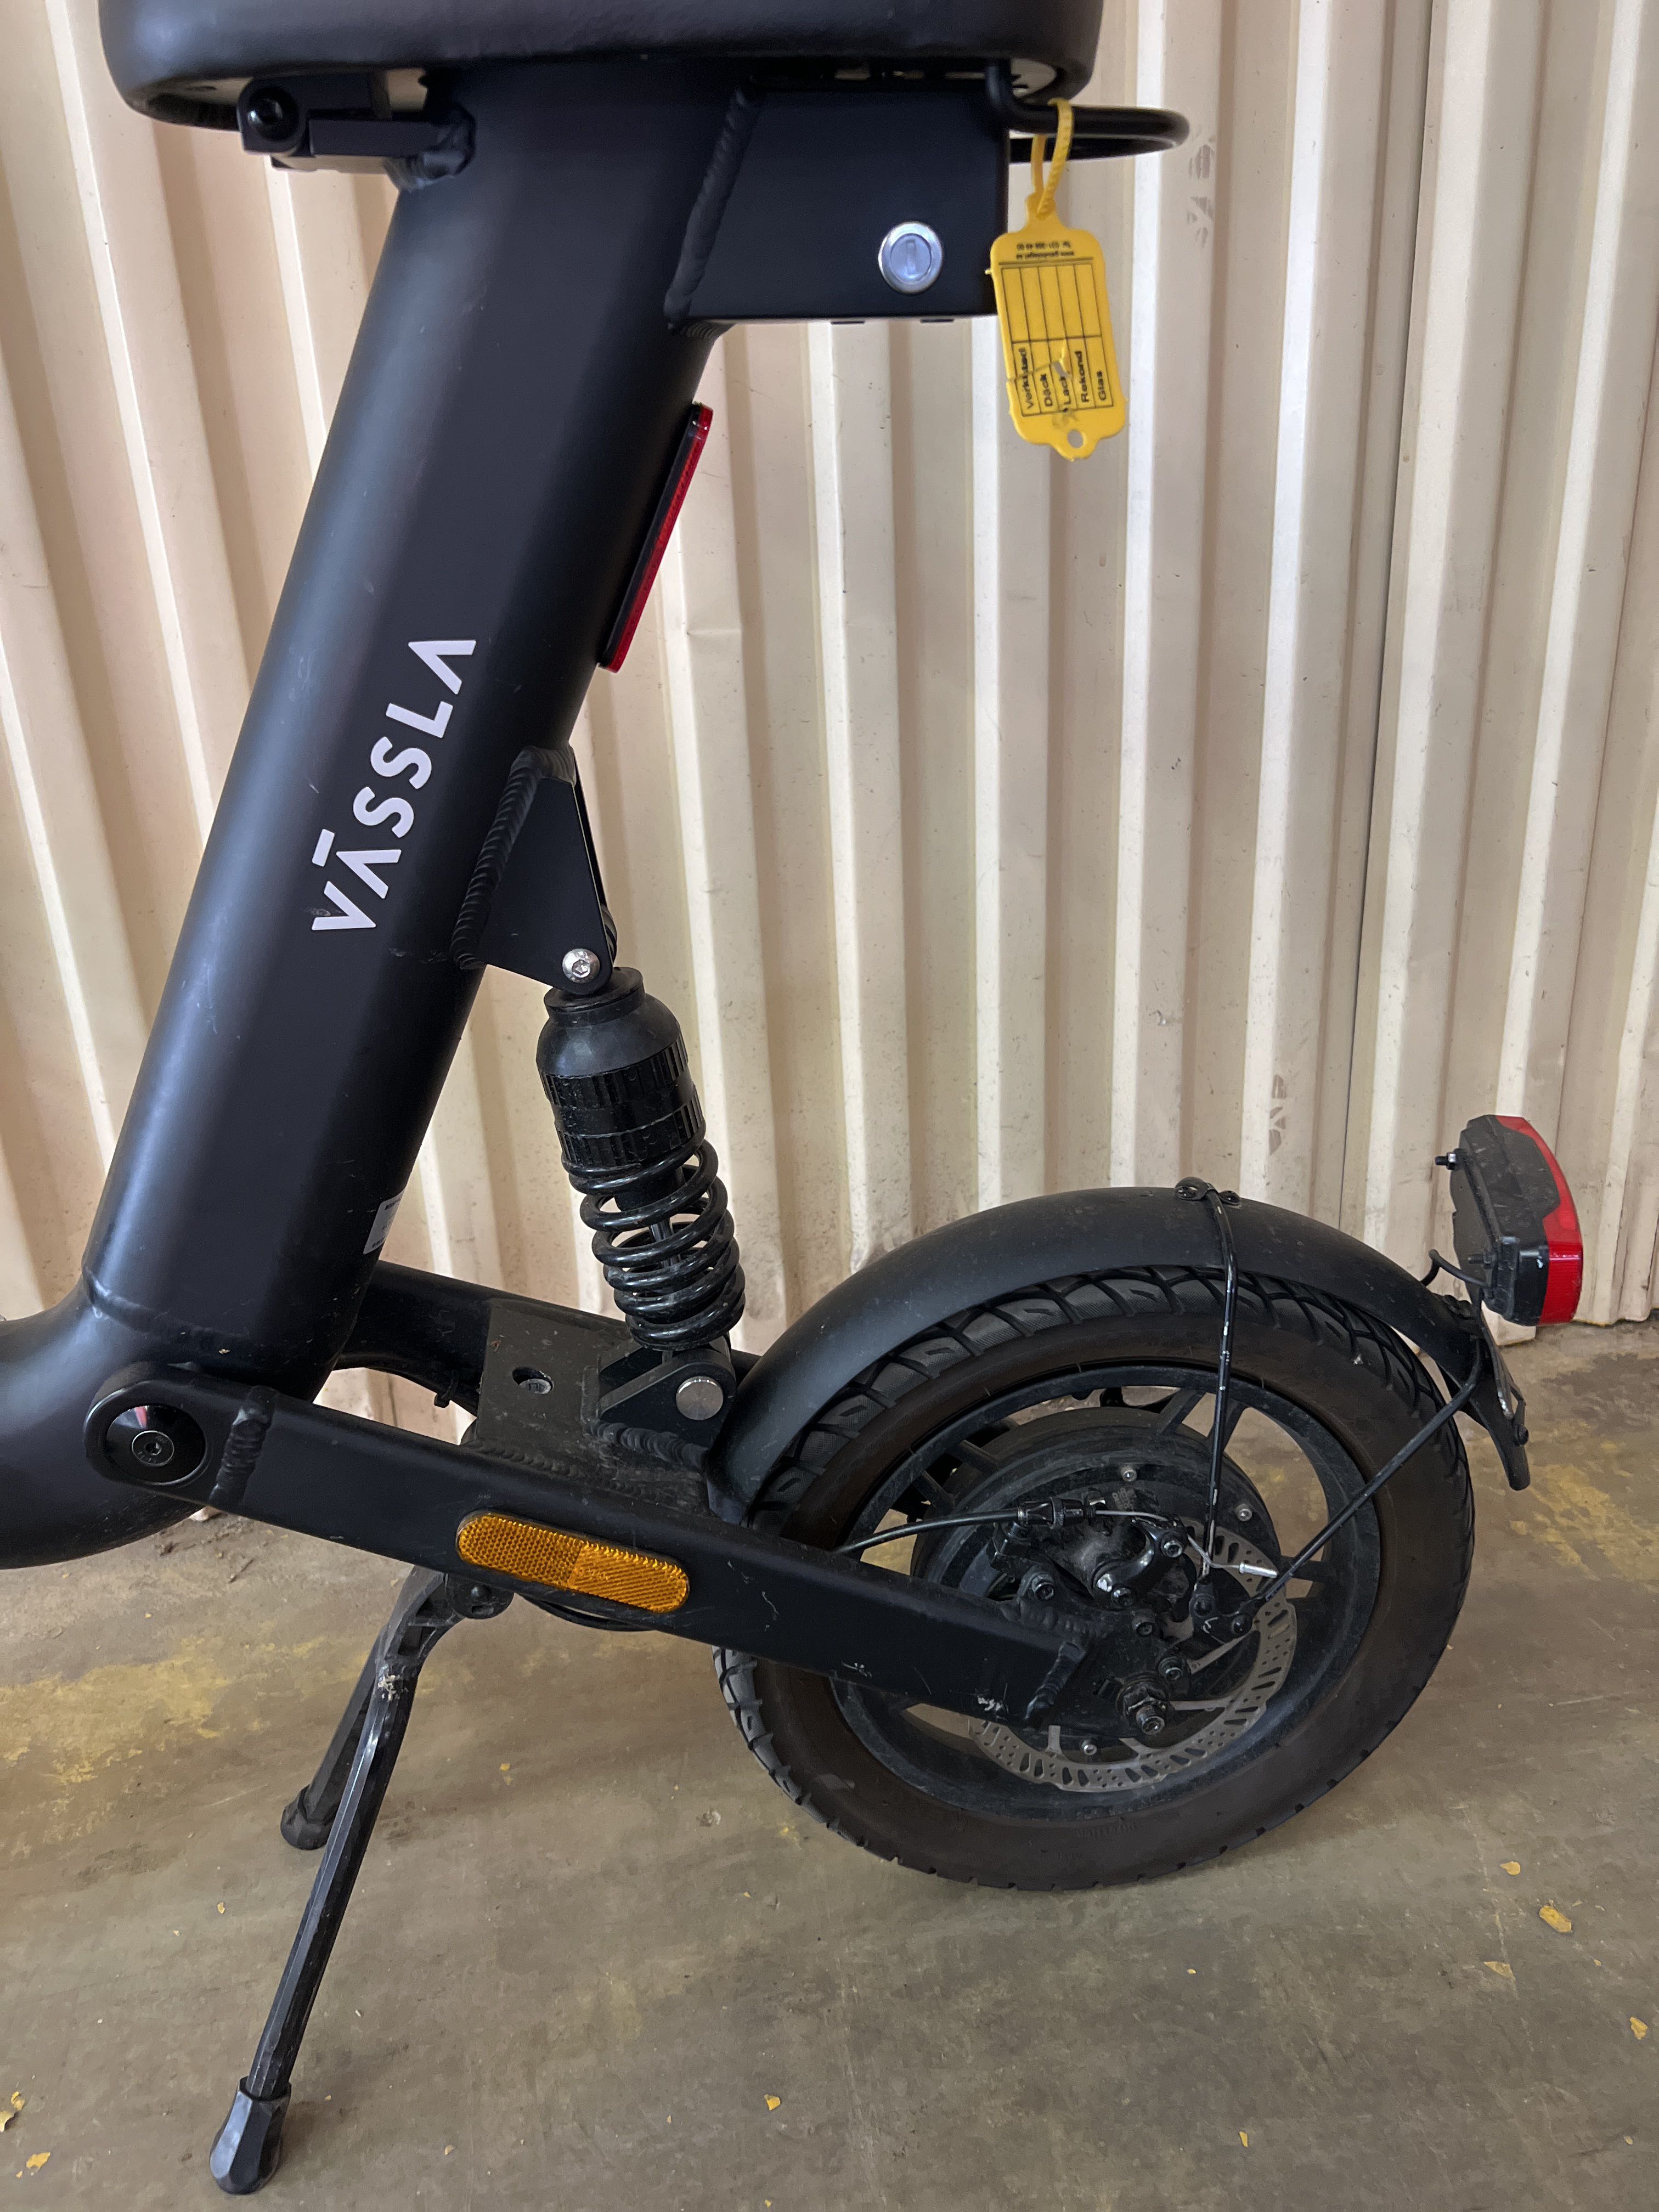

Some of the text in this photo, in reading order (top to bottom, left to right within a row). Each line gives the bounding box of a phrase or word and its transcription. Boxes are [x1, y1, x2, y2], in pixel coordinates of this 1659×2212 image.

[1040, 374, 1053, 407] Däck
[1075, 351, 1089, 403] Rekond
[1097, 371, 1107, 400] Glas
